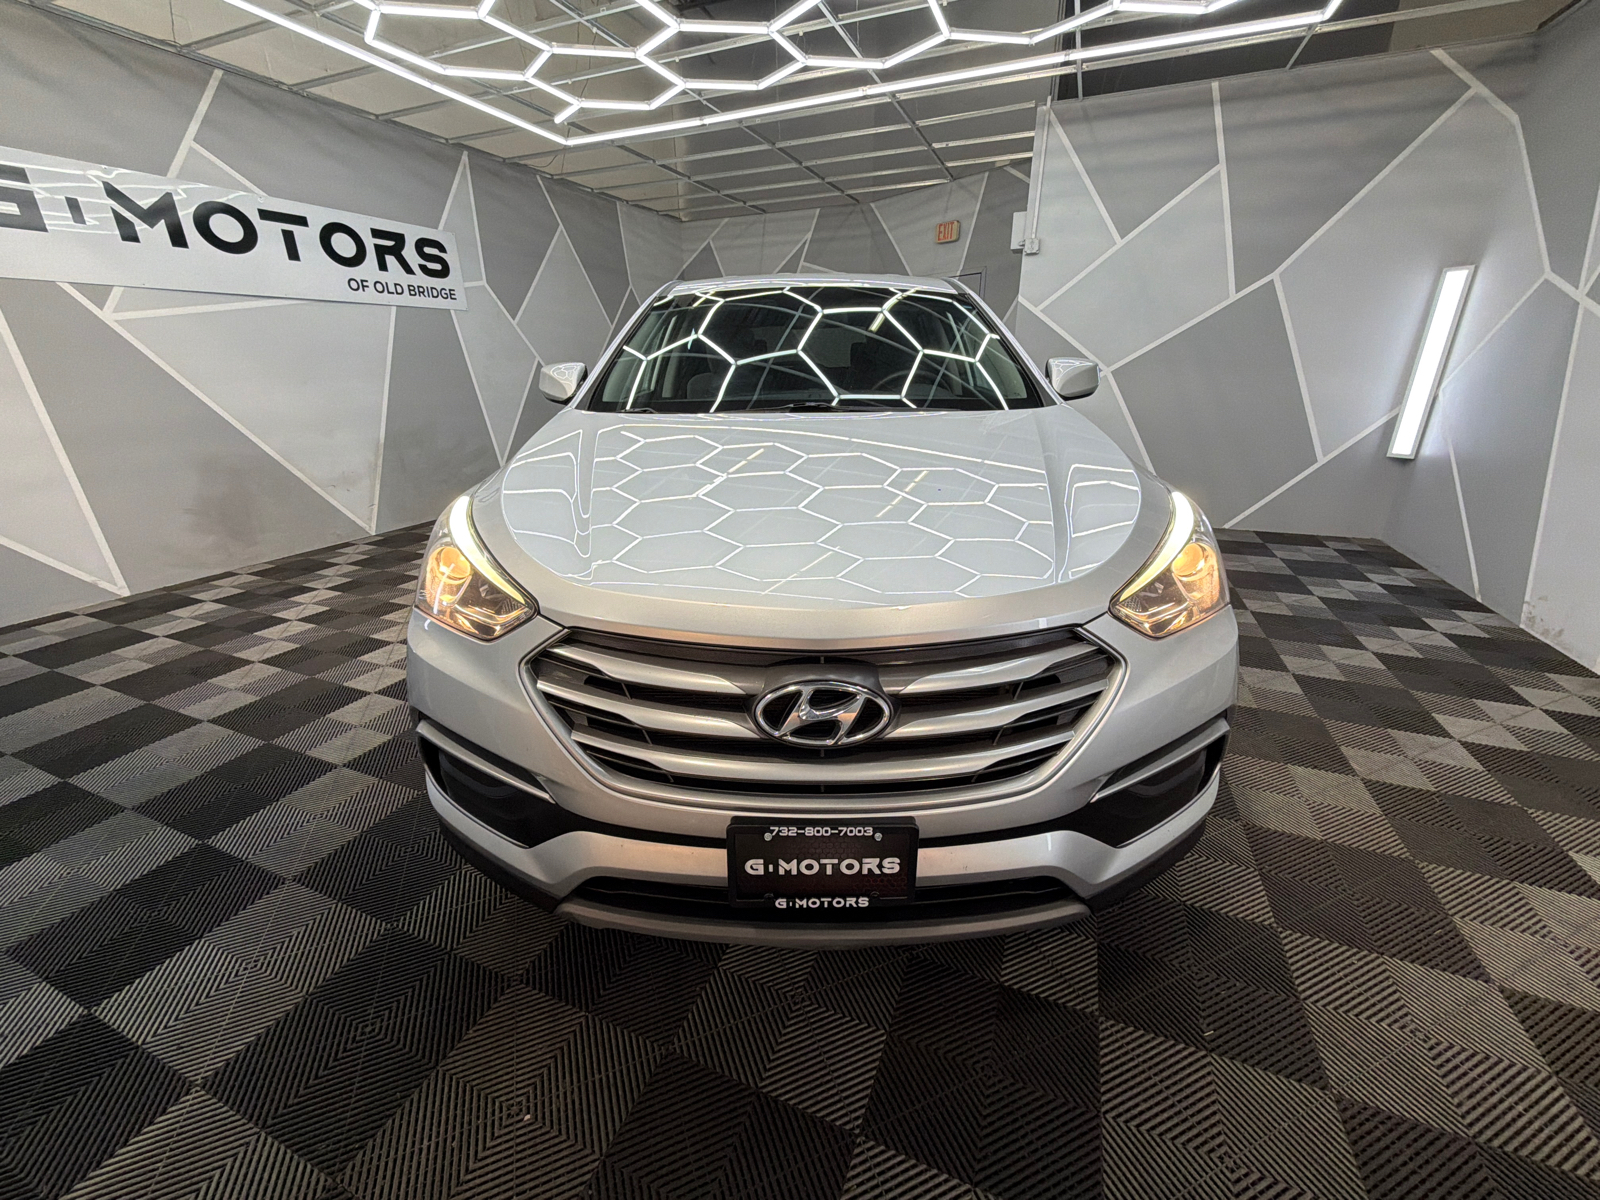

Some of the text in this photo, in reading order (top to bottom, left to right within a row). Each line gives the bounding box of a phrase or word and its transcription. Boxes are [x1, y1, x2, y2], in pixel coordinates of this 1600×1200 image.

[937, 221, 955, 242] EXIT
[347, 277, 458, 301] OF OLD BRIDGE
[769, 826, 874, 837] 732-800-7003
